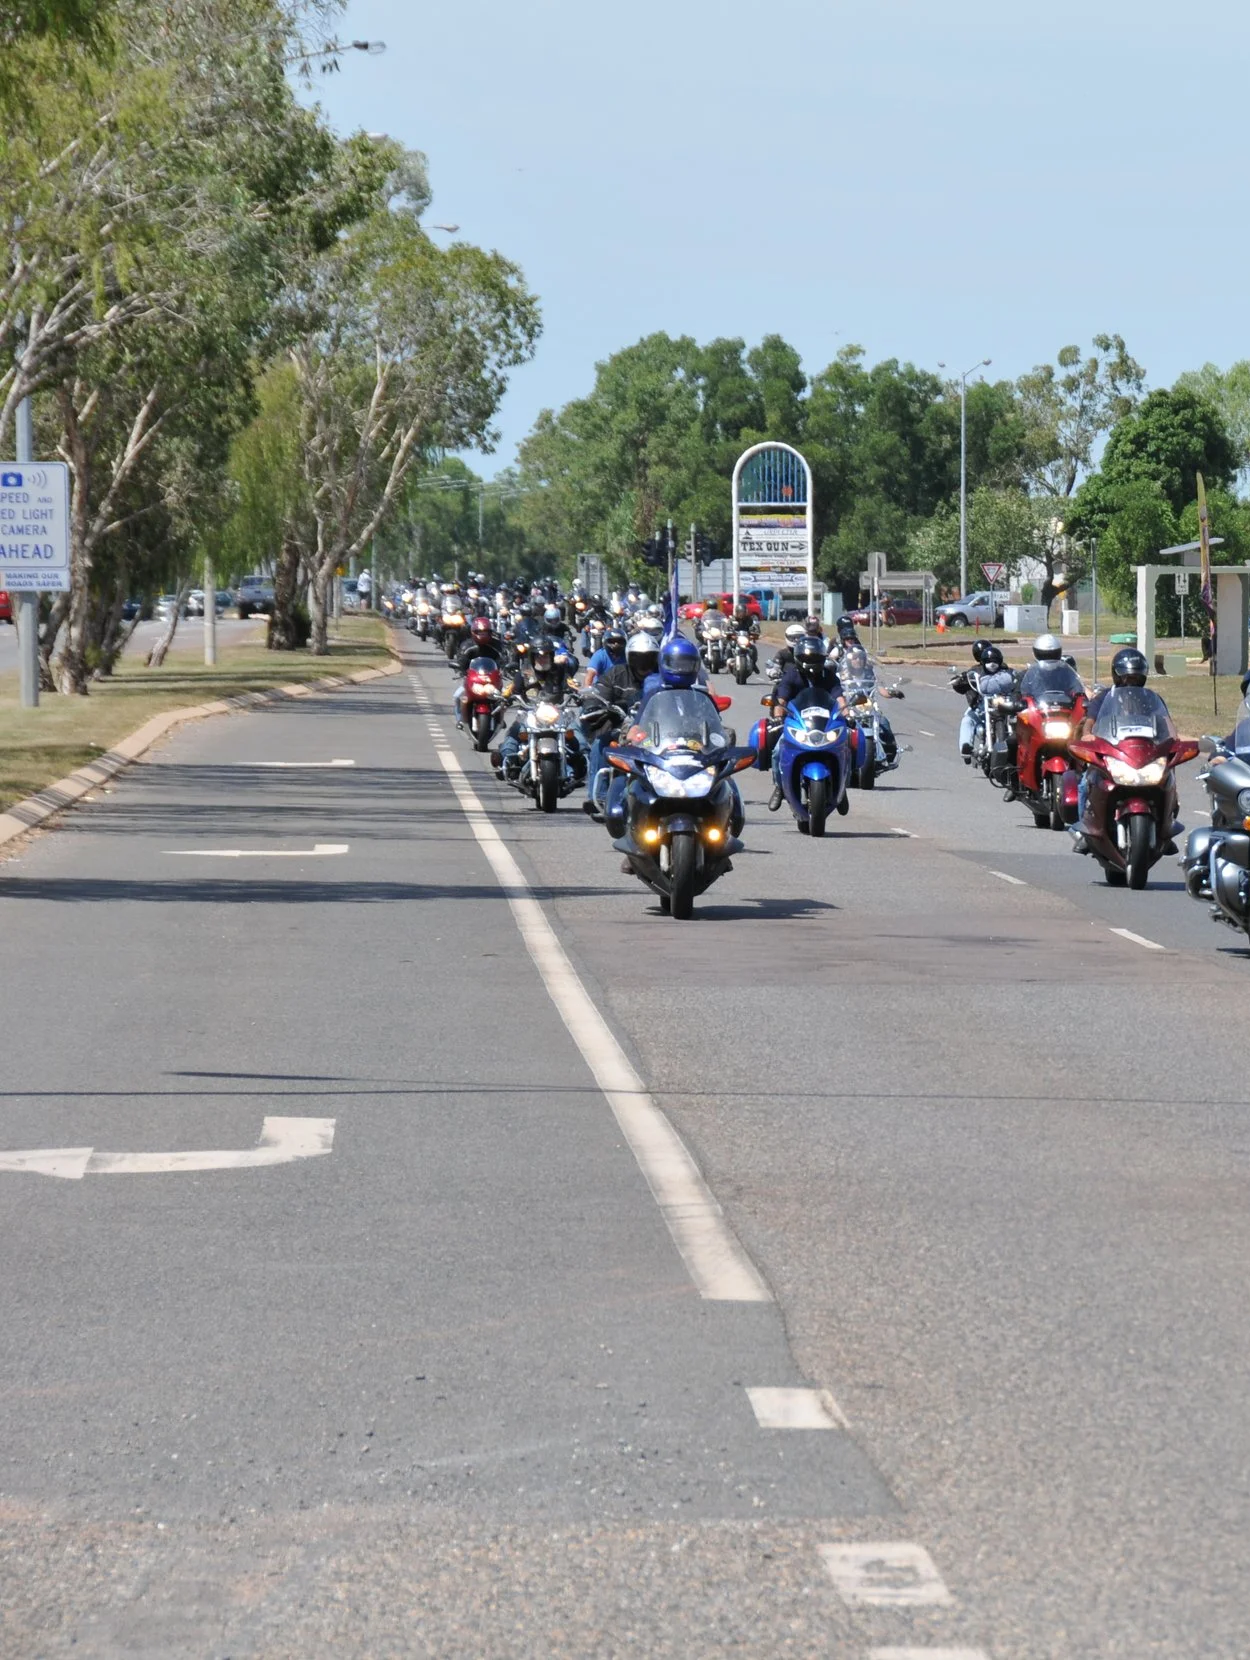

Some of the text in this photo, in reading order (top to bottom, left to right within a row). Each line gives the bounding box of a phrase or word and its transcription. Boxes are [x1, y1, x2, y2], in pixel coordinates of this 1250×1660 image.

[0, 492, 53, 504] PEED AND
[0, 508, 54, 520] ED LIGHT
[1, 524, 48, 535] CAMERA
[0, 544, 54, 559] AHEAD
[741, 542, 789, 551] TEX GUN
